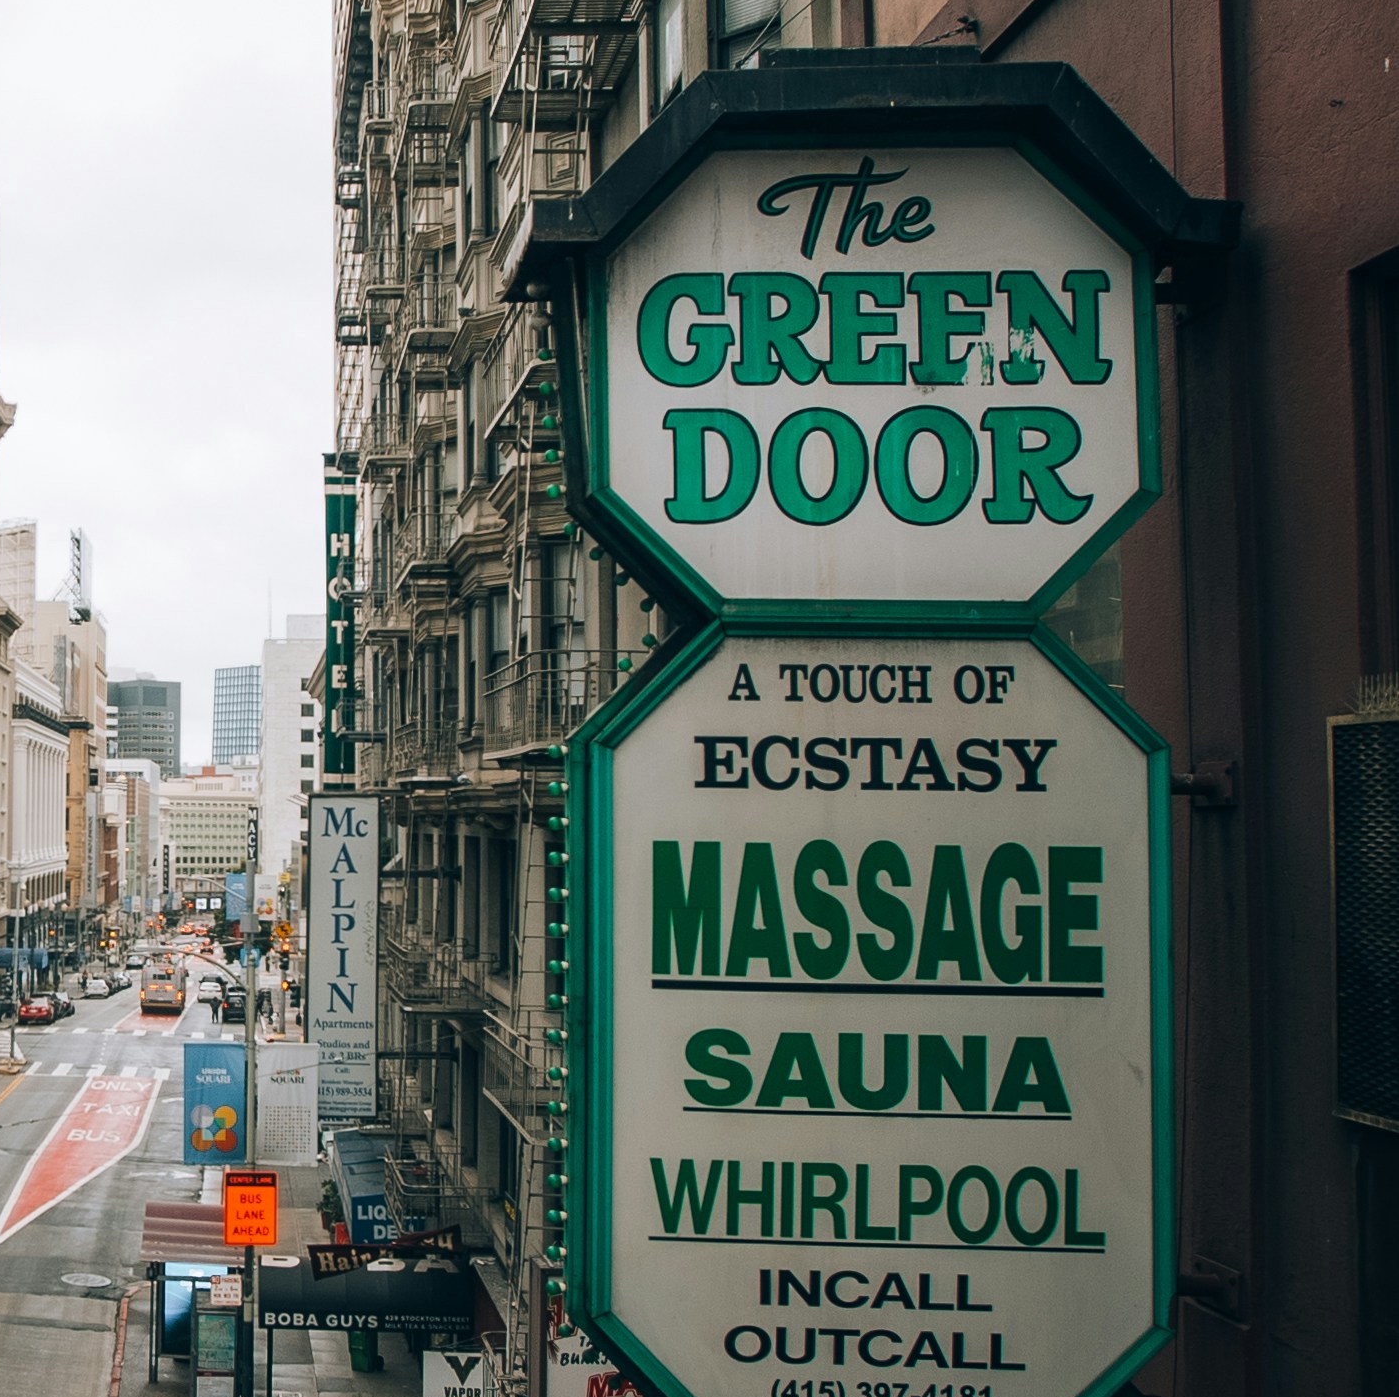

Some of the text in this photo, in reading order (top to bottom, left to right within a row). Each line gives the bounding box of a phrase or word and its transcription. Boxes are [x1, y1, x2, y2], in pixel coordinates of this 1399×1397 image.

[757, 156, 935, 259] The
[637, 269, 1112, 386] GREEN
[663, 405, 1094, 526] DOOR
[728, 664, 1015, 704] A TOUCH OF
[694, 735, 1057, 792] ECSTASY
[652, 839, 1103, 984] MASSAGE
[313, 1018, 374, 1030] Apartments
[353, 1040, 370, 1049] and
[683, 1028, 1071, 1112] SAUNA
[90, 1080, 152, 1092] ONLY
[82, 1102, 141, 1117] TAXI
[66, 1129, 121, 1142] BUS
[240, 1194, 263, 1204] BUS
[650, 1157, 1105, 1247] WHIRLPOOL
[236, 1210, 265, 1220] LANE
[233, 1226, 269, 1236] AHEAD
[317, 1249, 371, 1272] Hair
[759, 1269, 993, 1312] INCALL
[265, 1312, 378, 1328] BOBA GUYS
[723, 1325, 1026, 1371] OUTCALL
